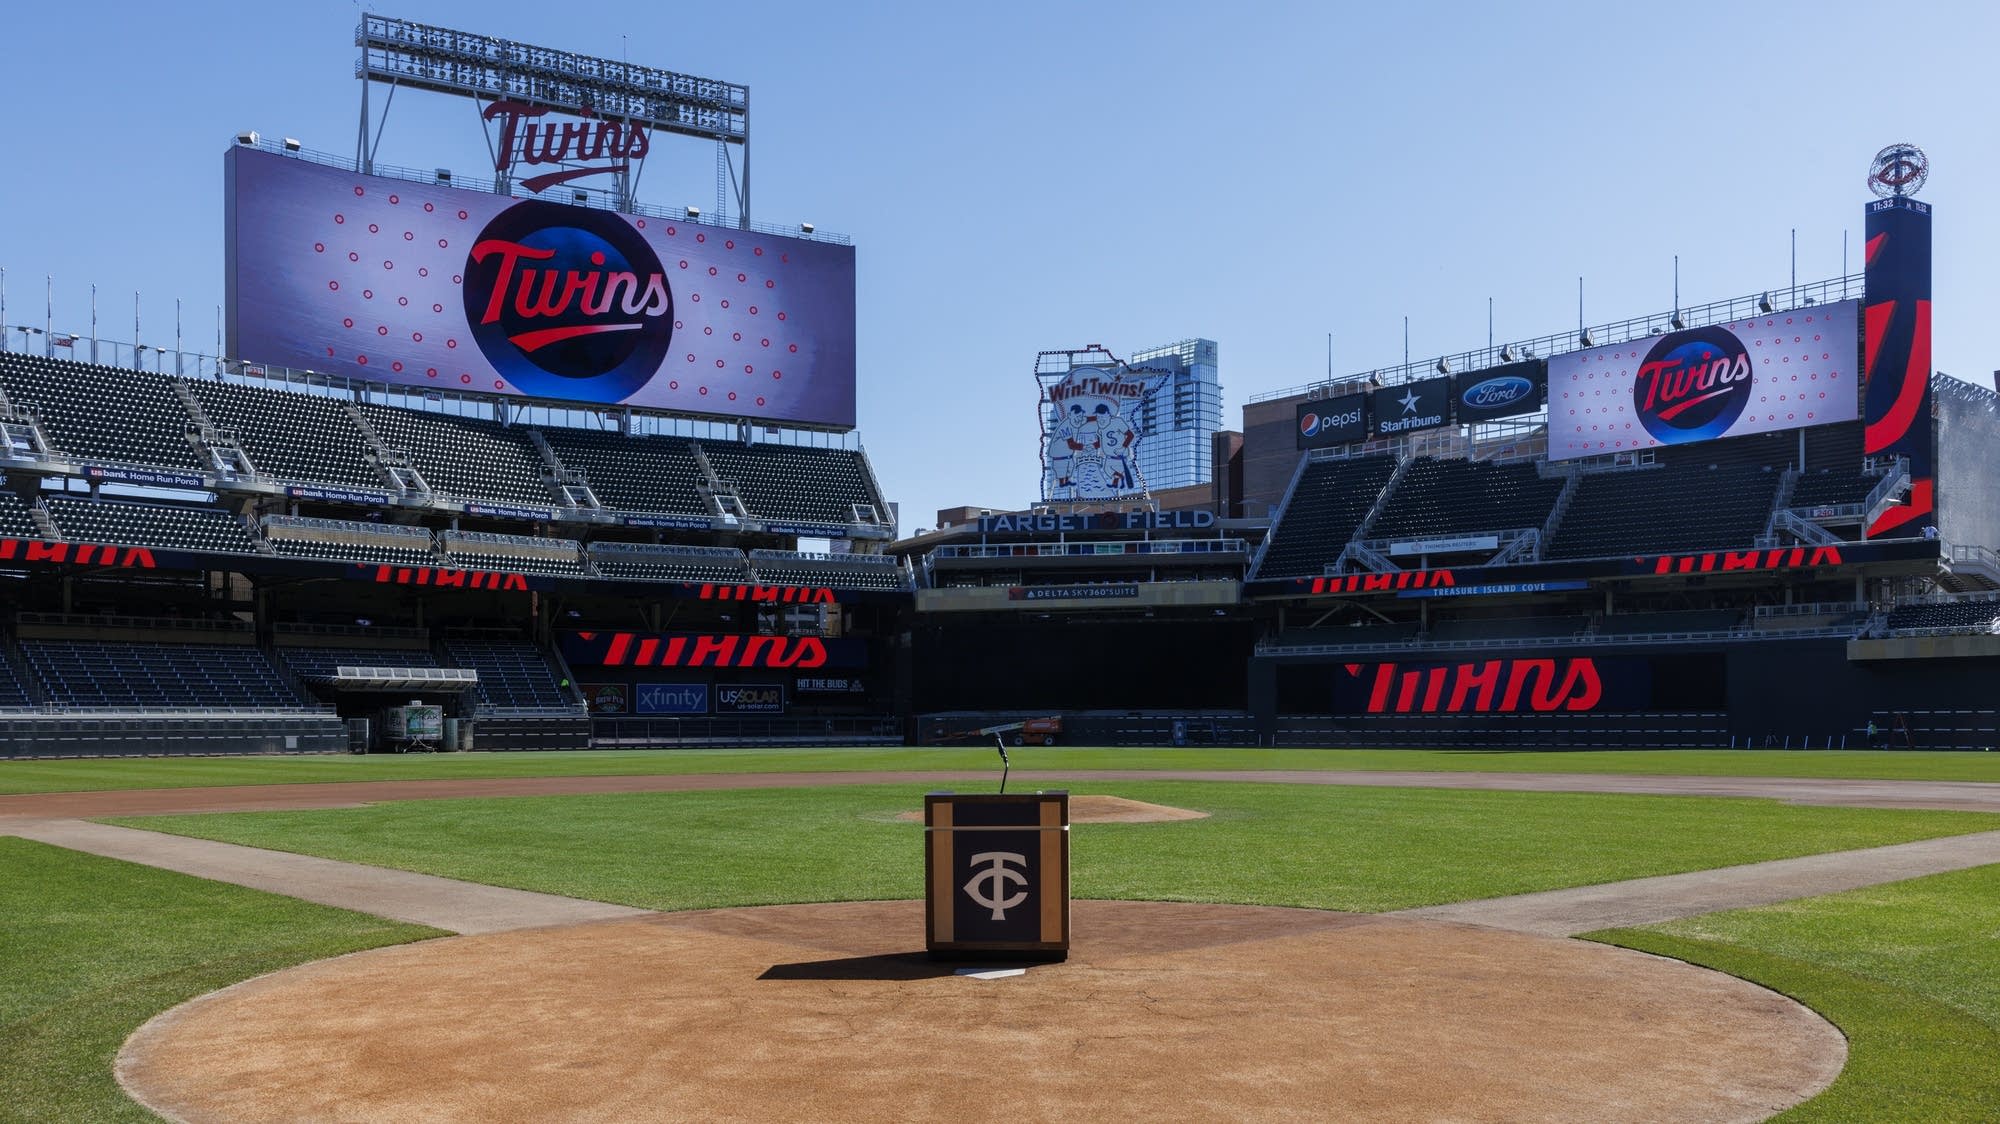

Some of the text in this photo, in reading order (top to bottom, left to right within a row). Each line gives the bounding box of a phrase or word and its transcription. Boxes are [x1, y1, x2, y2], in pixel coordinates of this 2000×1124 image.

[483, 101, 649, 172] Twins
[1873, 199, 1893, 211] 11:32
[471, 239, 669, 325] Twins
[1048, 376, 1146, 403] Win! Twins!
[1476, 381, 1518, 404] Ford
[1637, 351, 1750, 412] Twins
[1322, 407, 1361, 432] pepsi
[1380, 415, 1441, 433] StarTribune
[130, 472, 155, 481] Home
[156, 475, 173, 483] Run
[175, 476, 199, 486] Porch
[325, 491, 347, 500] Home
[348, 493, 363, 501] Run
[364, 495, 385, 503] Porch
[498, 508, 517, 516] Home
[978, 510, 1215, 532] TARGET FIELD
[1434, 583, 1546, 597] TREASURE ISLAND COVE
[797, 679, 811, 689] HIT
[812, 679, 826, 689] THE
[827, 679, 848, 689] BUDS
[641, 687, 704, 710] xfinity
